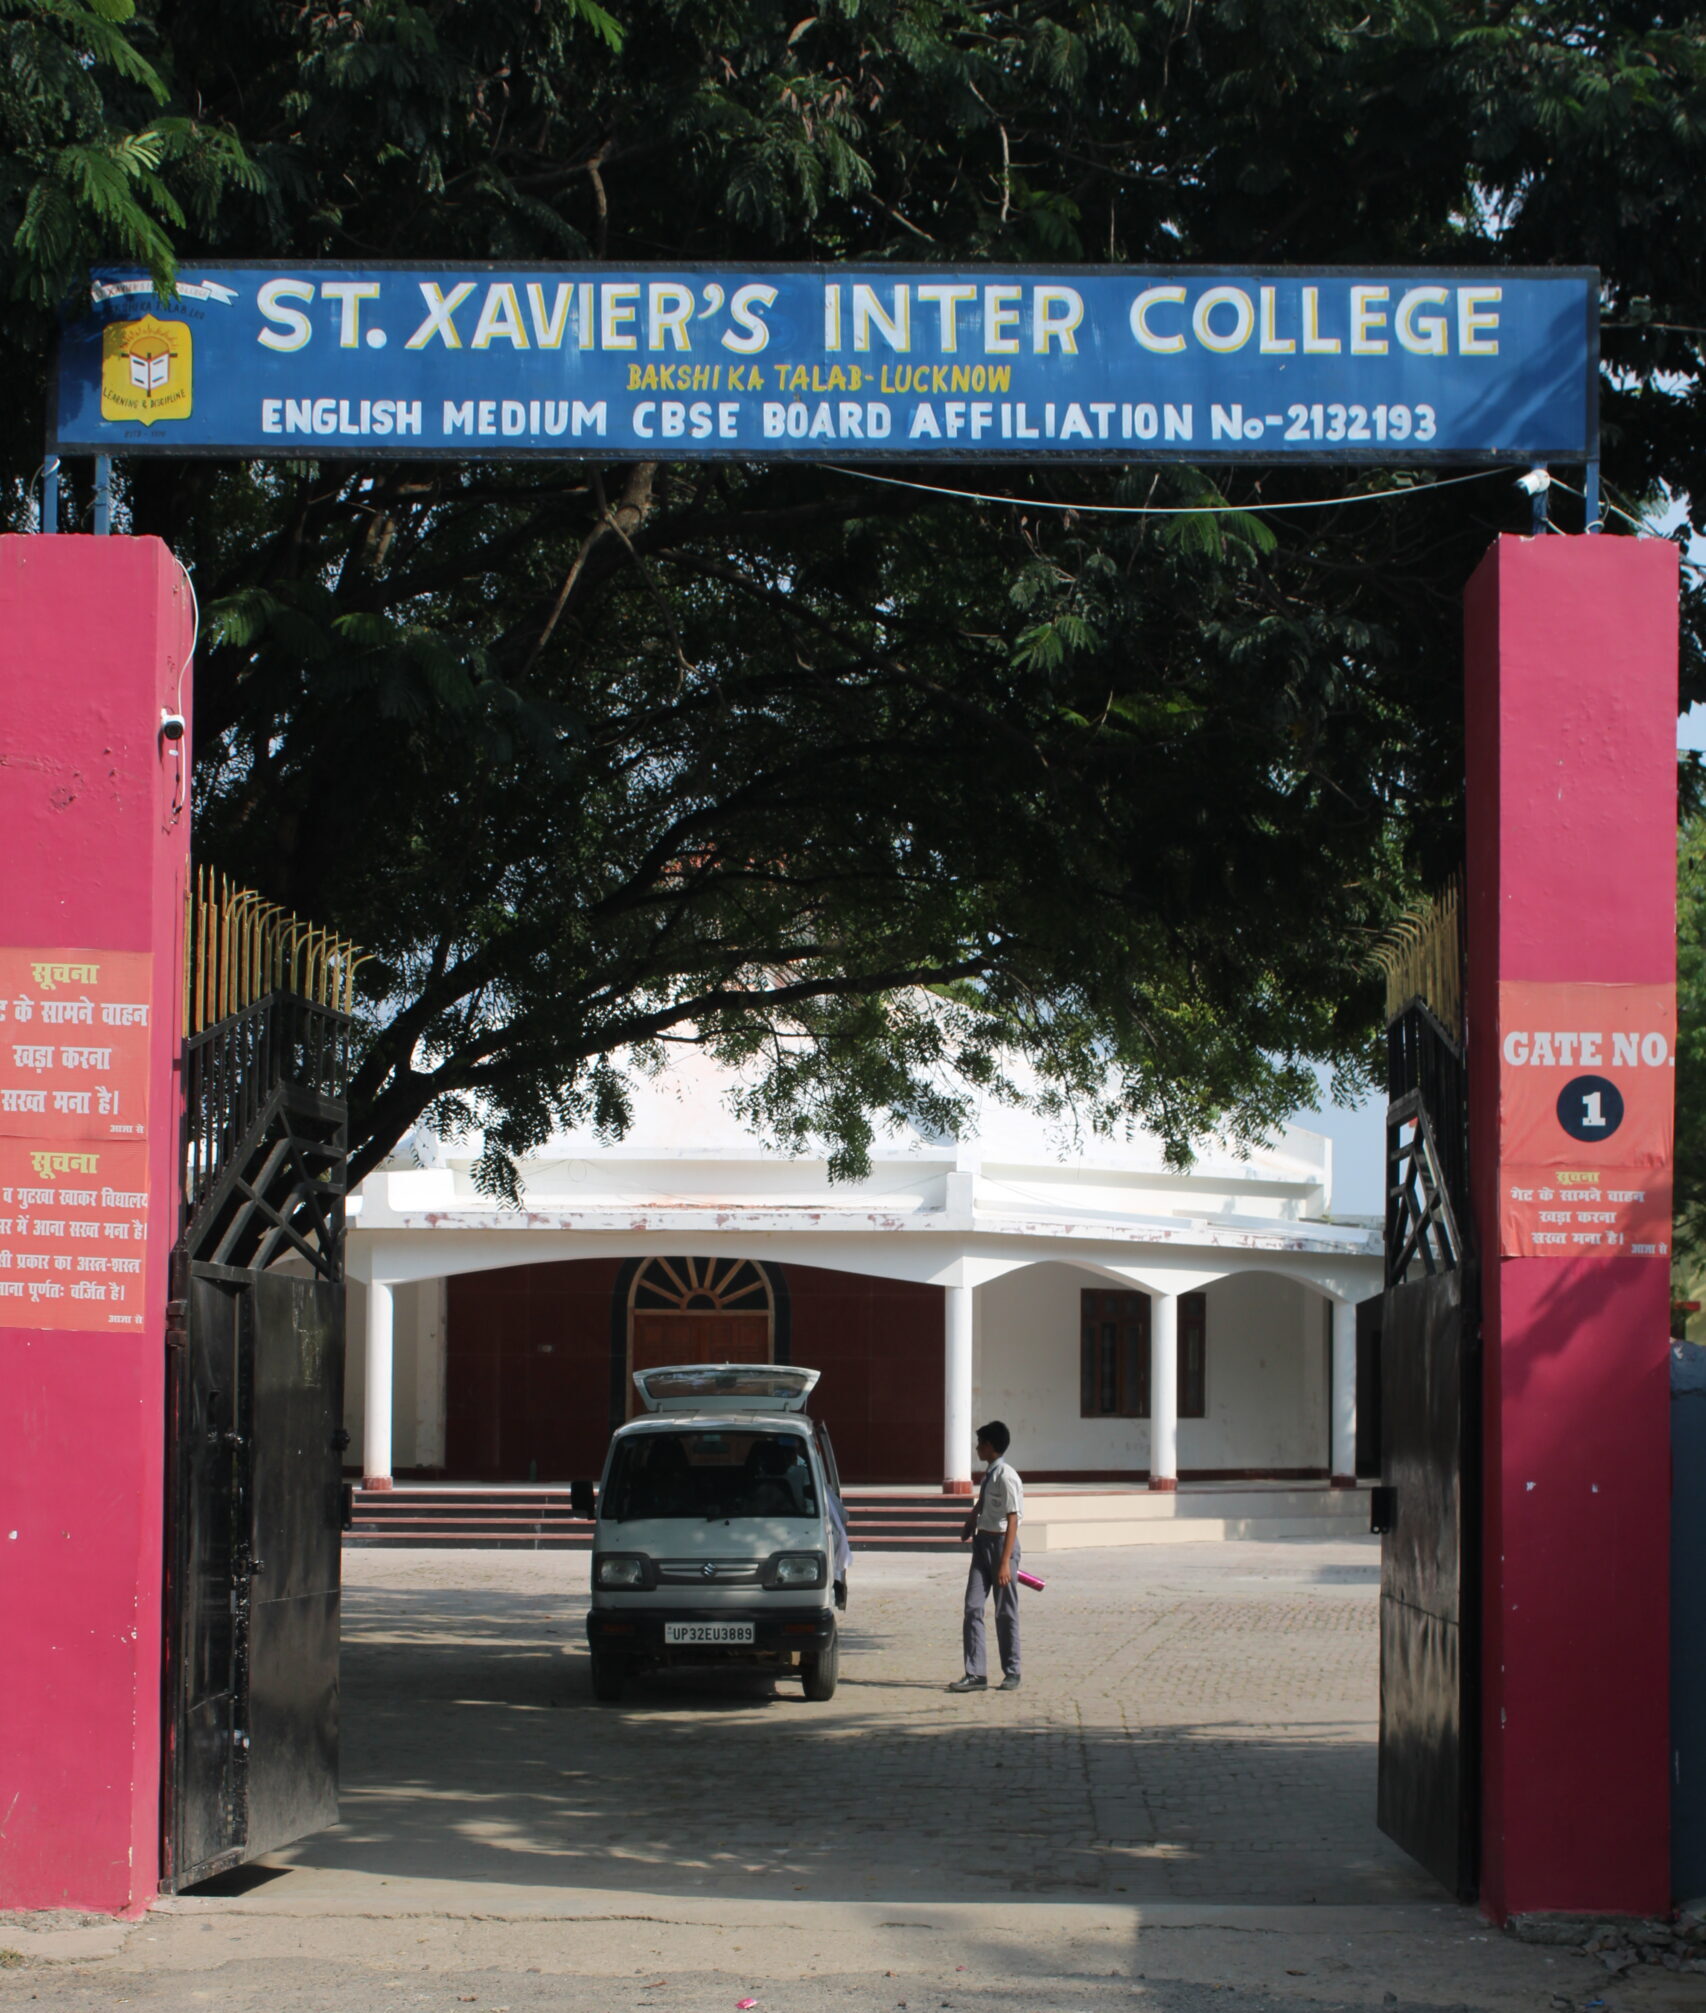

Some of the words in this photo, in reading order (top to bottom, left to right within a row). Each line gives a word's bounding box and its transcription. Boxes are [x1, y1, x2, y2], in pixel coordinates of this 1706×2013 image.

[256, 278, 387, 352] ST.
[404, 281, 779, 354] XAVIER'S
[825, 283, 1085, 355] INTER
[1129, 285, 1502, 356] COLLEGE
[626, 363, 720, 391] BAKSHI
[727, 364, 765, 391] KA
[150, 388, 186, 409] DISCIPLINE
[261, 398, 422, 436] ENGLISH
[443, 400, 607, 437] MEDIUM
[632, 401, 740, 439] CBSE
[763, 401, 892, 440] BOARD
[909, 402, 1193, 441] AFFILIATION
[31, 962, 100, 990] सूचना
[13, 994, 35, 1022] के
[40, 996, 95, 1024] सामने
[100, 1003, 149, 1026] वाहन
[12, 1045, 55, 1073] खड़ा
[60, 1046, 112, 1070] करना
[1503, 1031, 1602, 1067] GATE
[1612, 1031, 1675, 1067] NO.
[0, 1089, 47, 1113] सख्त
[52, 1091, 91, 1114] मना
[1582, 1091, 1606, 1126] 1
[30, 1152, 100, 1180] सूचना
[1556, 1171, 1600, 1185] सूचना
[59, 1189, 98, 1208] खाकर
[1511, 1186, 1534, 1201] गेट
[1538, 1186, 1554, 1201] के
[1560, 1187, 1602, 1202] सामने
[1607, 1190, 1645, 1203] वाहन
[16, 1214, 31, 1235] में
[33, 1219, 66, 1237] आना
[69, 1221, 100, 1238] सख्त
[104, 1222, 130, 1239] मना
[1539, 1210, 1572, 1225] खड़ा
[1576, 1211, 1617, 1224] करना
[1571, 1232, 1602, 1245] मना
[16, 1253, 50, 1269] प्रकार
[54, 1254, 73, 1270] का
[673, 1627, 753, 1641] UP32EU3889
